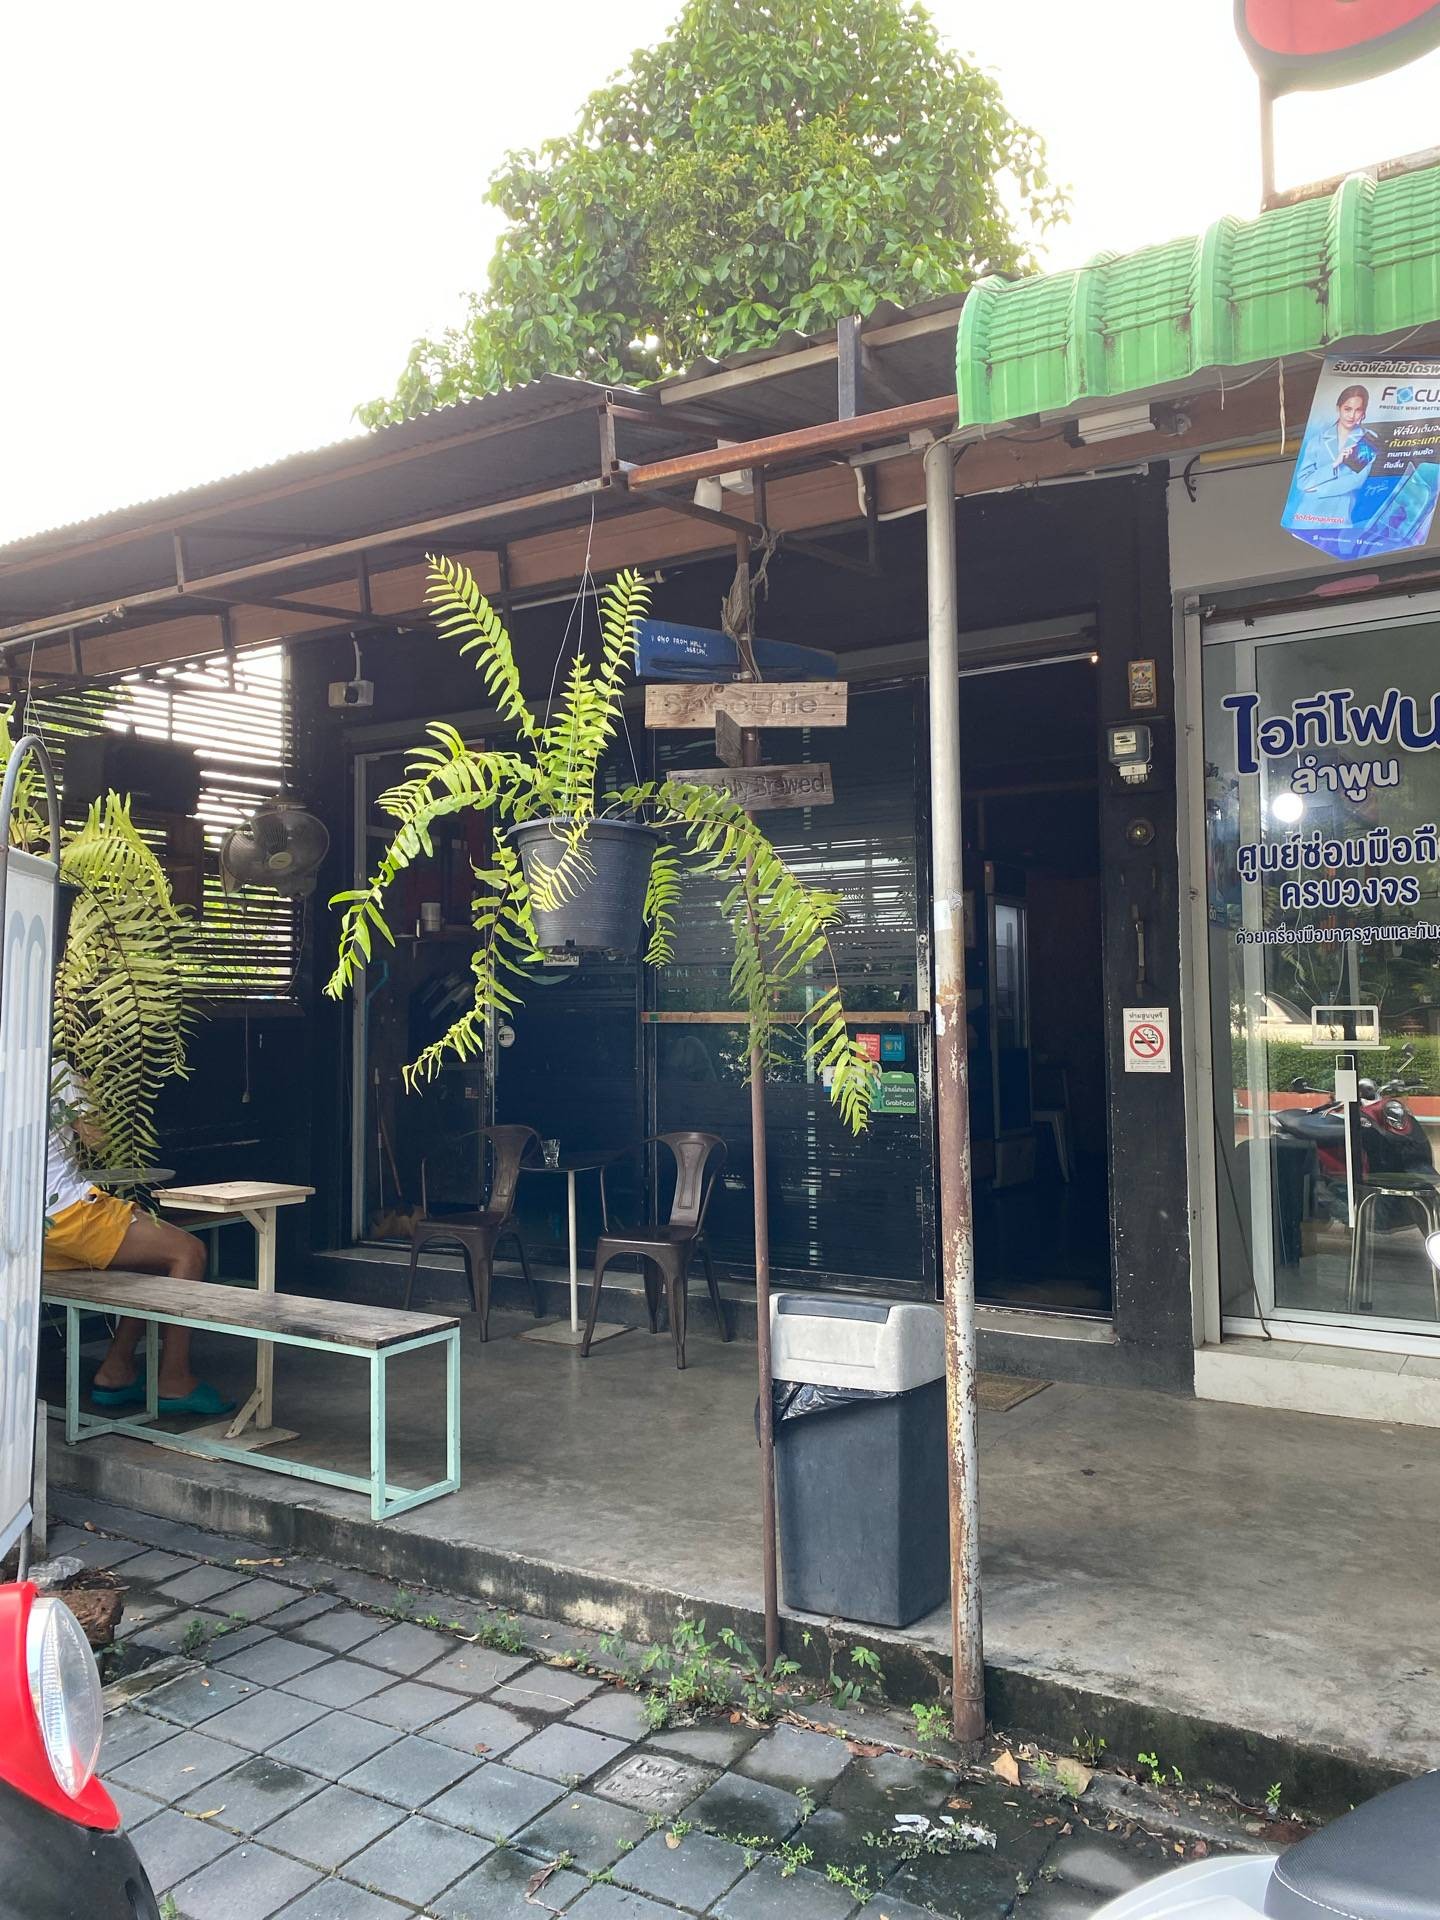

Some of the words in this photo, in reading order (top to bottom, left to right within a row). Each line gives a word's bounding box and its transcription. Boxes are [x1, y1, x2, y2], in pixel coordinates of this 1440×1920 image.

[1381, 386, 1440, 404] FOCU
[1221, 687, 1440, 776] ไอทีโฟน
[753, 771, 826, 796] Brewed
[1291, 755, 1399, 803] ลำพูน
[1237, 823, 1440, 884] ศูนย์ซ่อมมือถื
[1280, 876, 1420, 910] ครบวงจร
